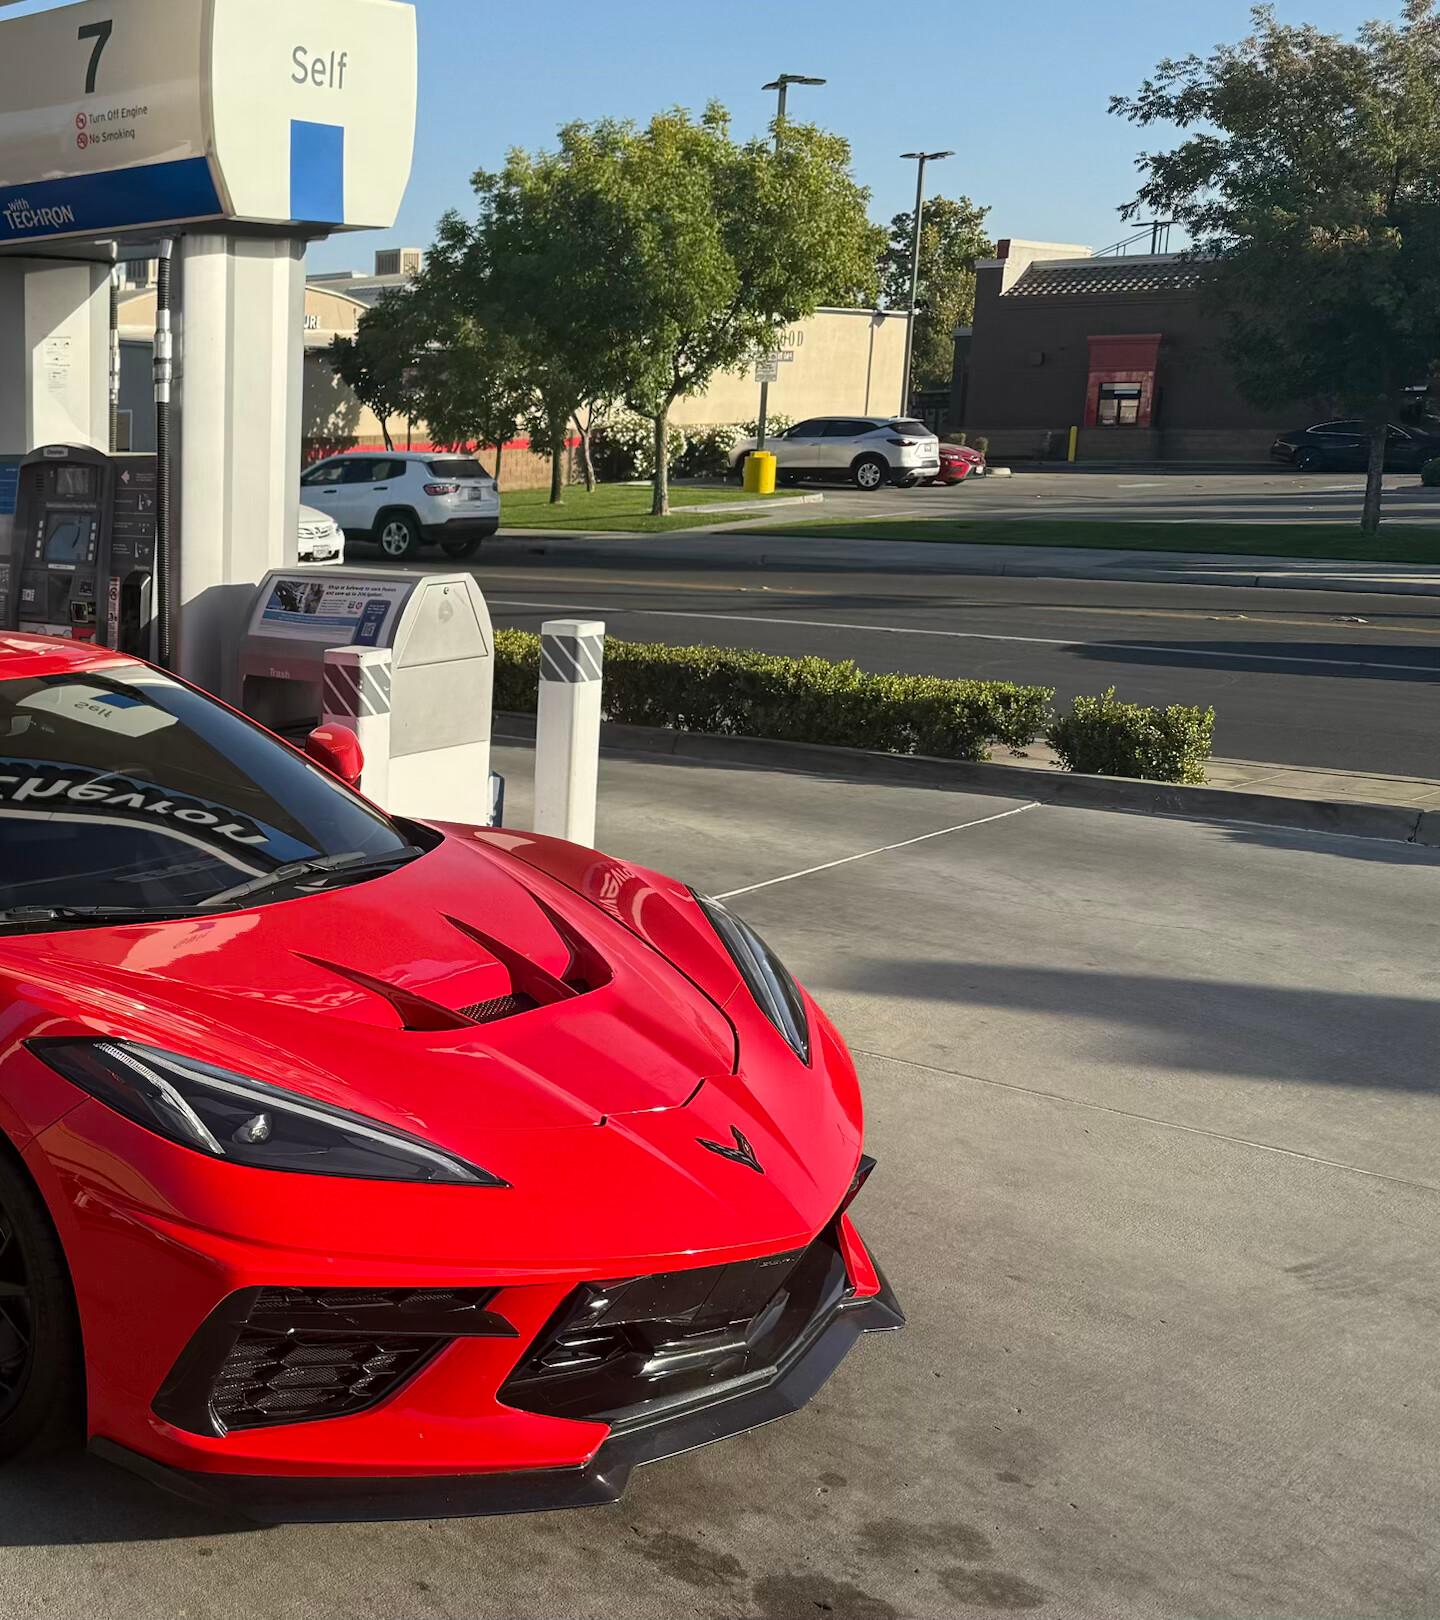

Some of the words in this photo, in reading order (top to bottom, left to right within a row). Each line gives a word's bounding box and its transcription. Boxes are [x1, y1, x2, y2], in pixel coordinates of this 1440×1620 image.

[77, 18, 113, 95] 7
[291, 45, 348, 90] Self
[88, 114, 106, 124] Turn
[107, 108, 119, 121] Off
[121, 105, 148, 118] Engine
[89, 133, 100, 144] No
[102, 128, 136, 142] Smoking
[8, 197, 30, 211] with
[2, 205, 75, 230] TECHRON
[269, 667, 290, 680] Trash
